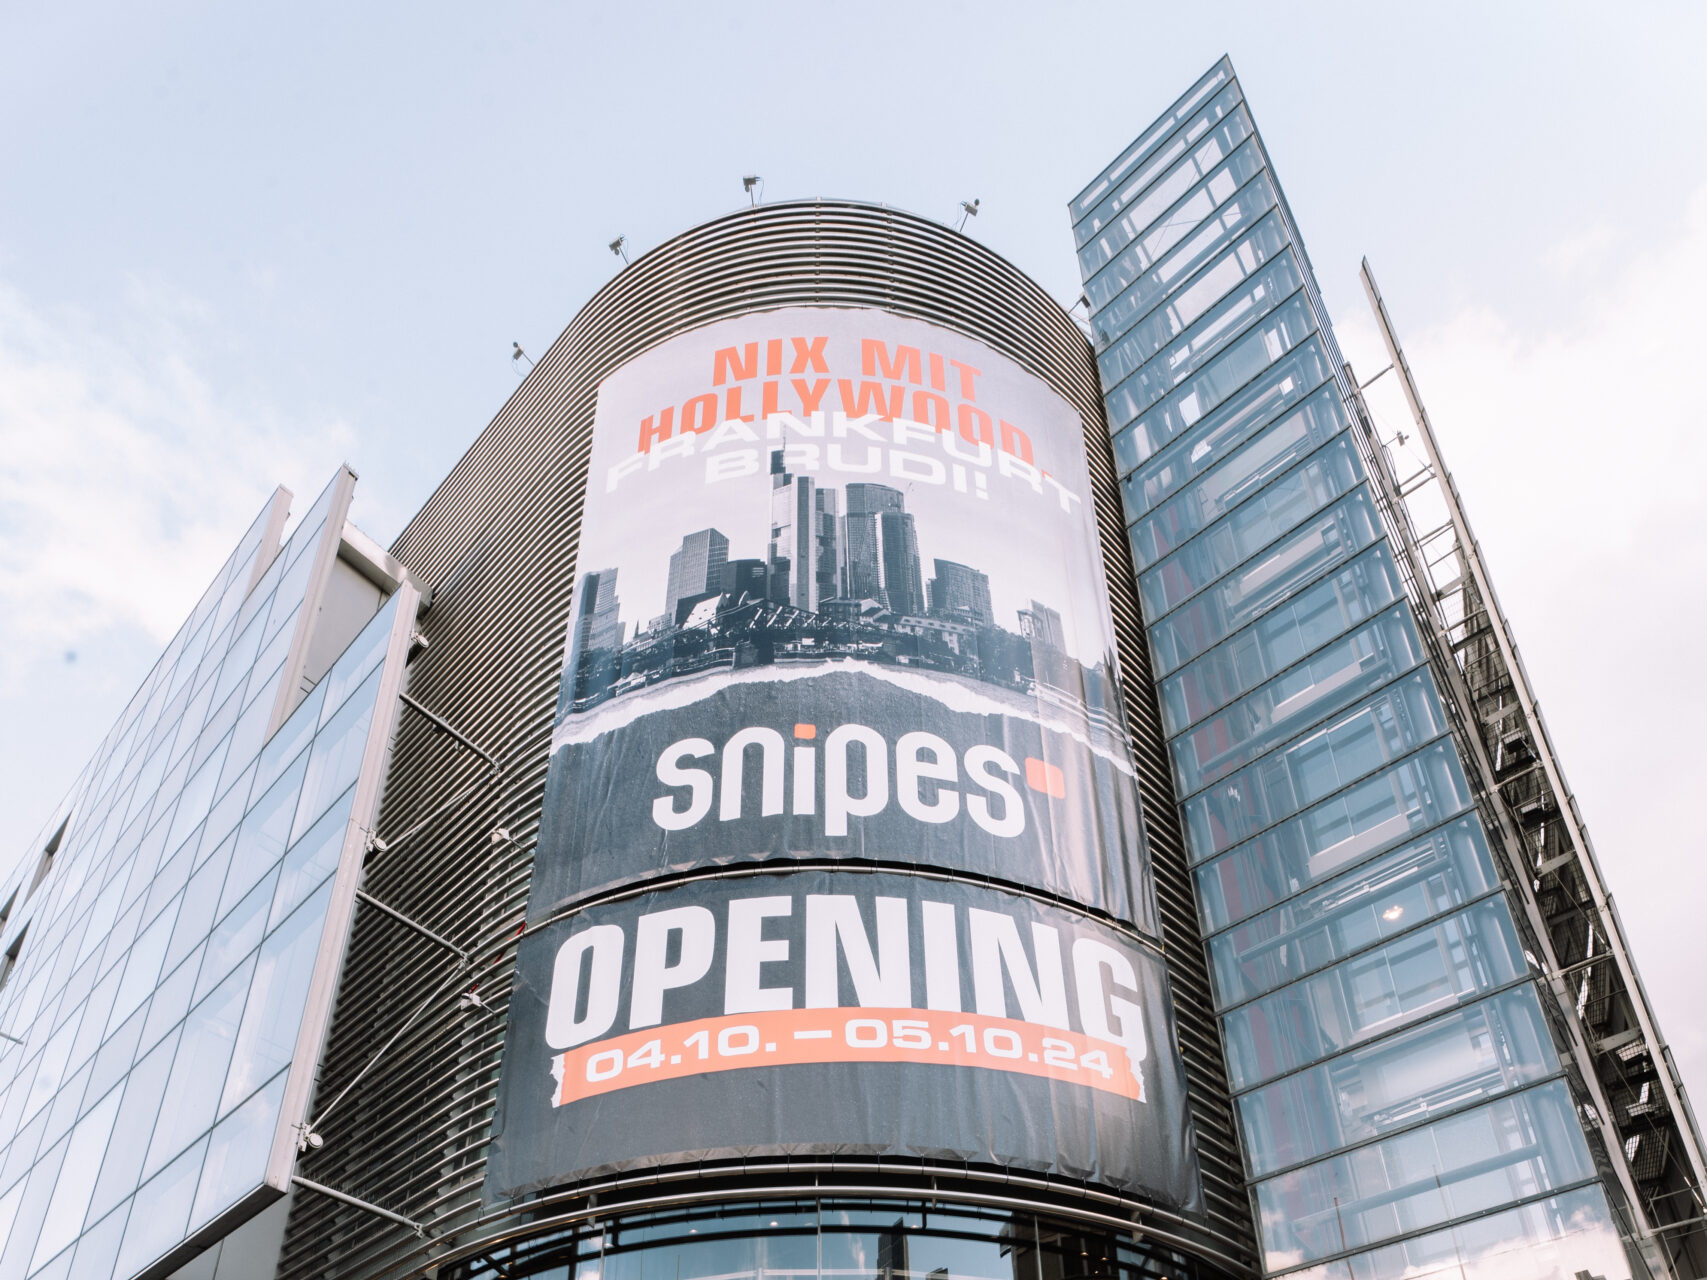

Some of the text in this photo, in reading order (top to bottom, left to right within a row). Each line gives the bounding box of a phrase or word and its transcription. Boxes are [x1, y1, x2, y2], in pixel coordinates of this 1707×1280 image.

[712, 336, 982, 402] NIX MIT
[605, 411, 1082, 514] FRANKFURT
[638, 378, 1053, 478] HOLLYWOOD
[705, 443, 989, 500] BRUDI!
[652, 723, 1025, 838] snipes
[545, 894, 1148, 1062] OPENING
[586, 1025, 777, 1083] 04.10.
[844, 1018, 1114, 1079] 05.10.24
